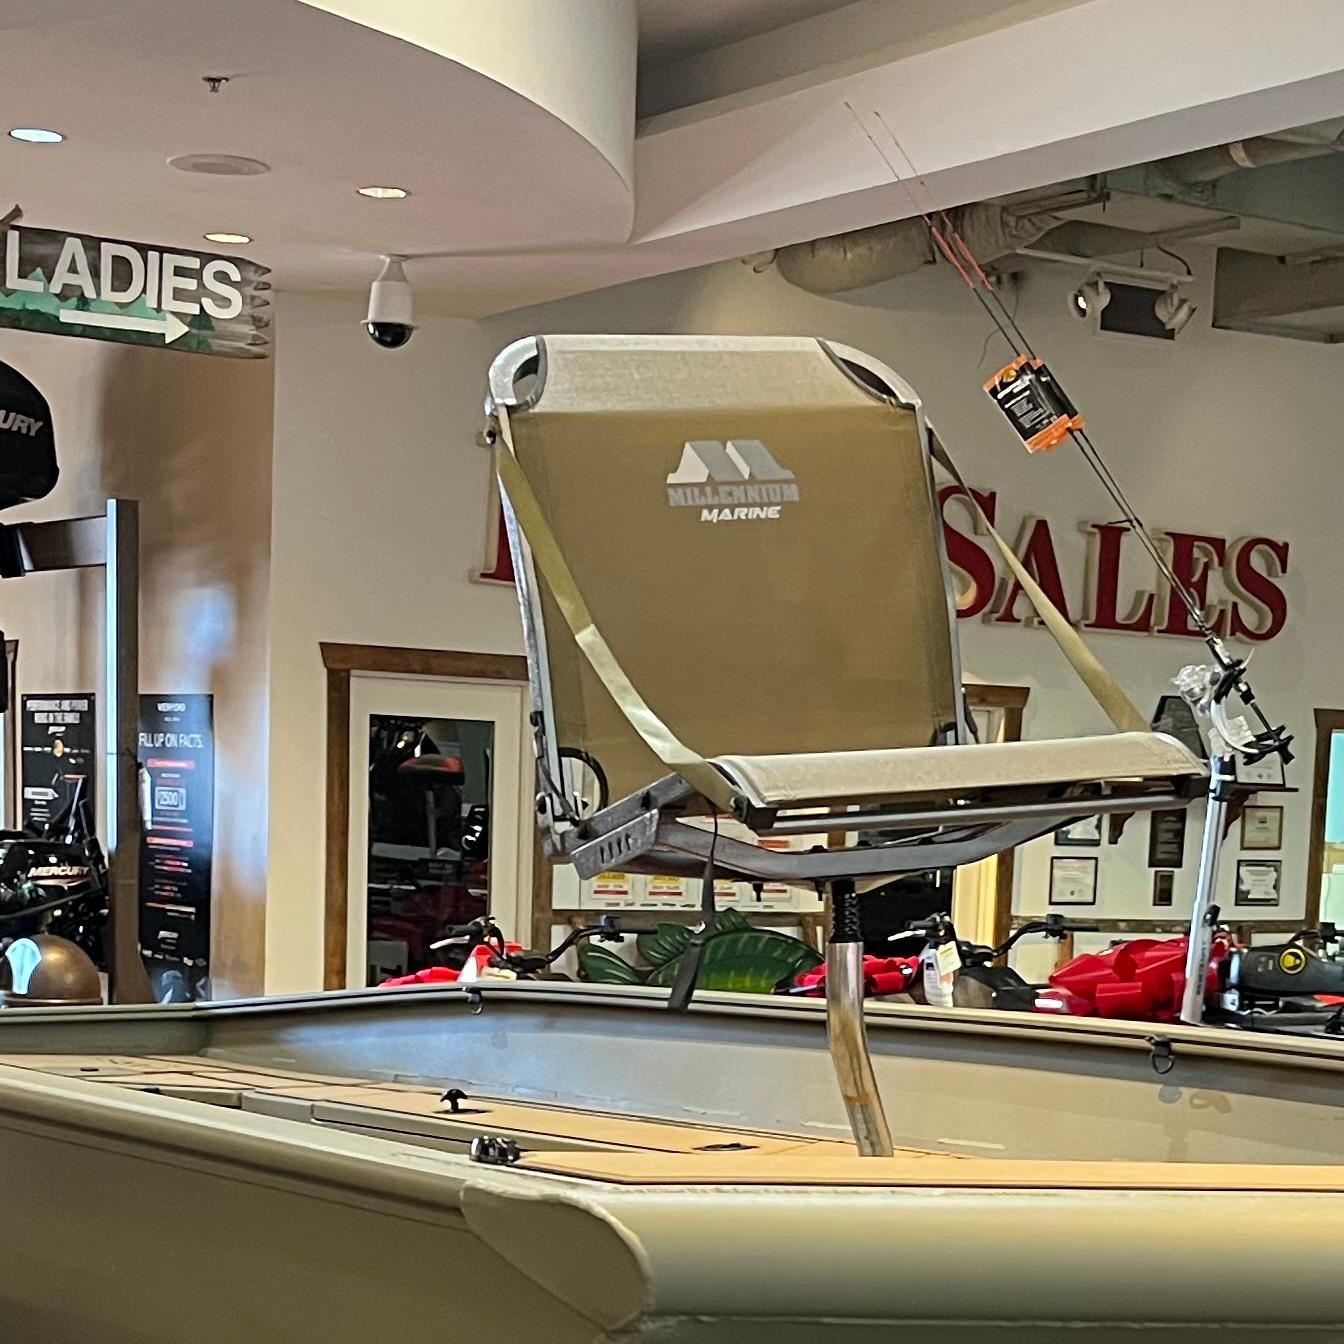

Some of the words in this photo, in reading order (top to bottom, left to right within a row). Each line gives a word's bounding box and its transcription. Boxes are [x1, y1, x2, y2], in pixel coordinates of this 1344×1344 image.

[4, 229, 243, 320] LADIES
[667, 483, 800, 507] MILLENNIUM
[700, 505, 782, 523] MARINE
[938, 484, 1289, 641] SALES
